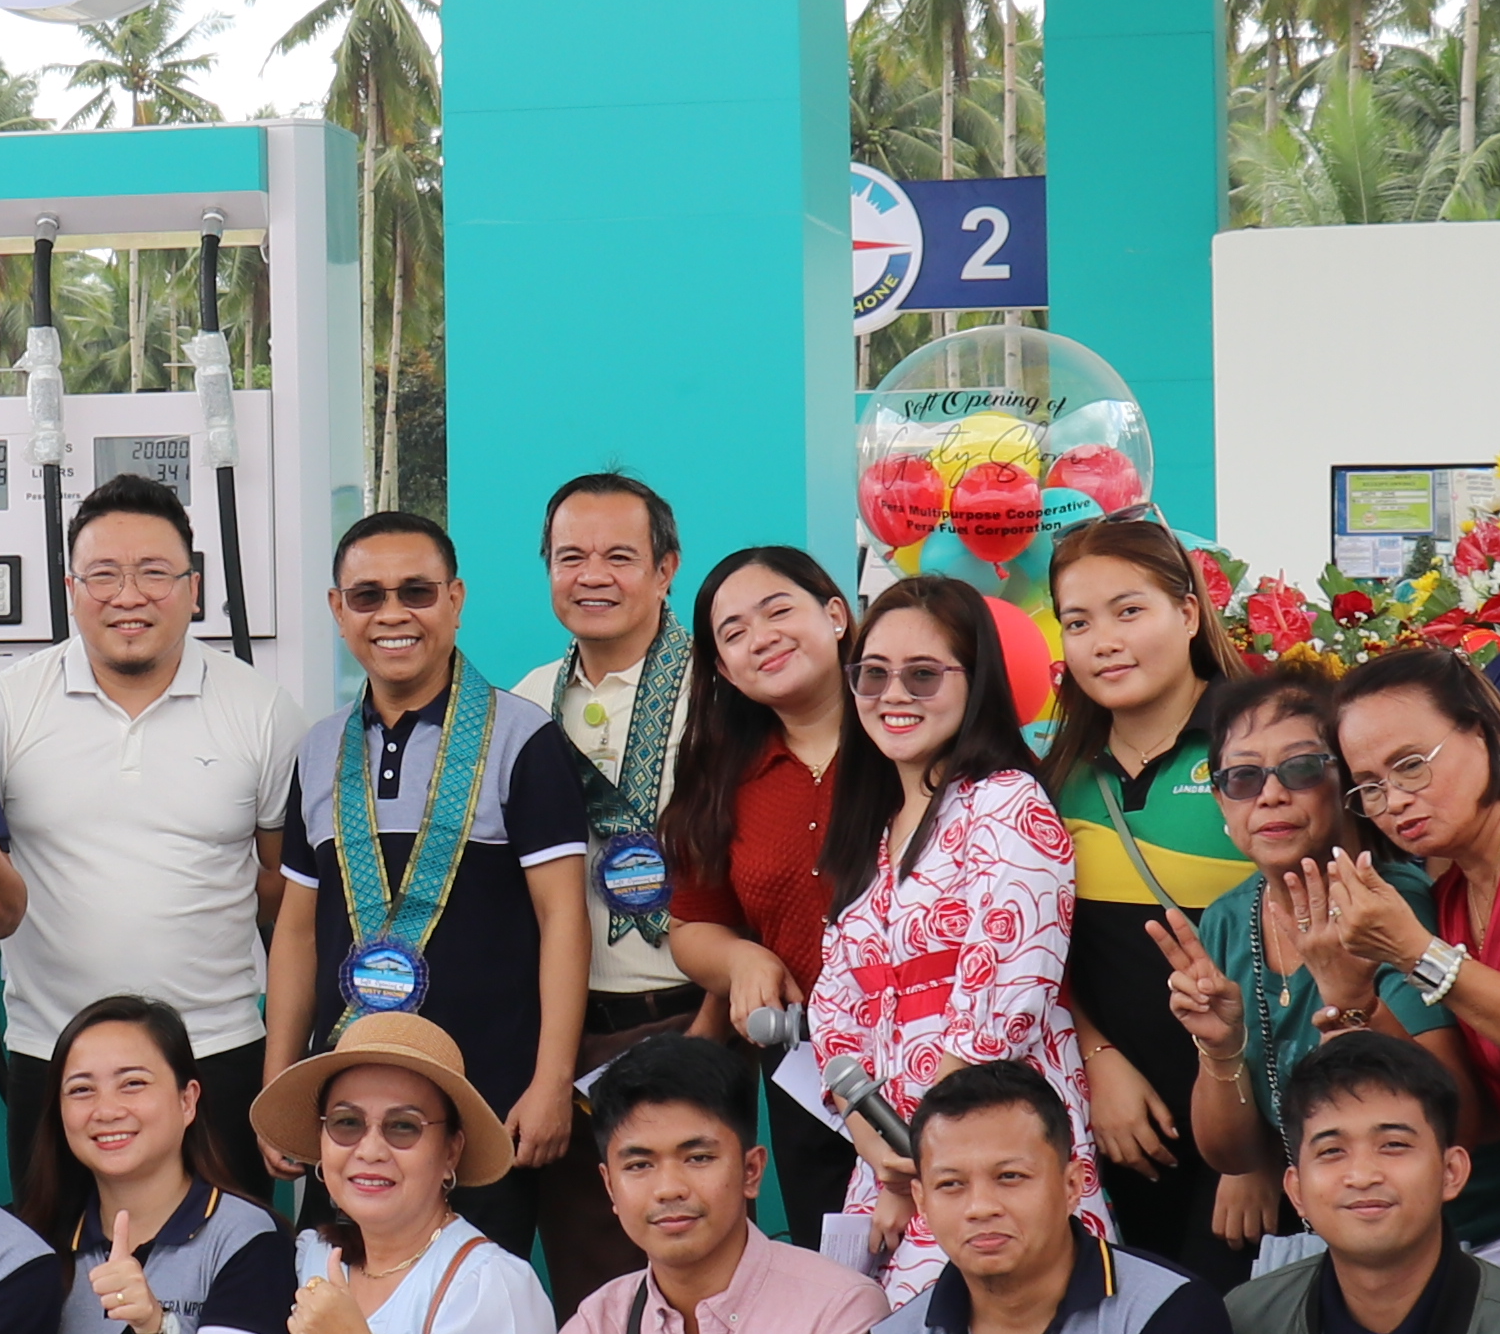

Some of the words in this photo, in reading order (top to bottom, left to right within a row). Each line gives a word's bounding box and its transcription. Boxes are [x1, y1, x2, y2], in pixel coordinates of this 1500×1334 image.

[961, 206, 1011, 280] 2
[853, 273, 900, 313] HONE
[898, 391, 944, 424] Soft
[941, 391, 1041, 416] Opening
[1047, 396, 1068, 418] of
[31, 467, 75, 478] LIRS
[909, 505, 1001, 522] Multipurpose
[1006, 498, 1091, 520] Cooperative
[906, 519, 936, 533] Pera
[939, 524, 969, 535] Fuel
[973, 520, 1062, 536] Corporation
[1172, 784, 1212, 794] LANDBA
